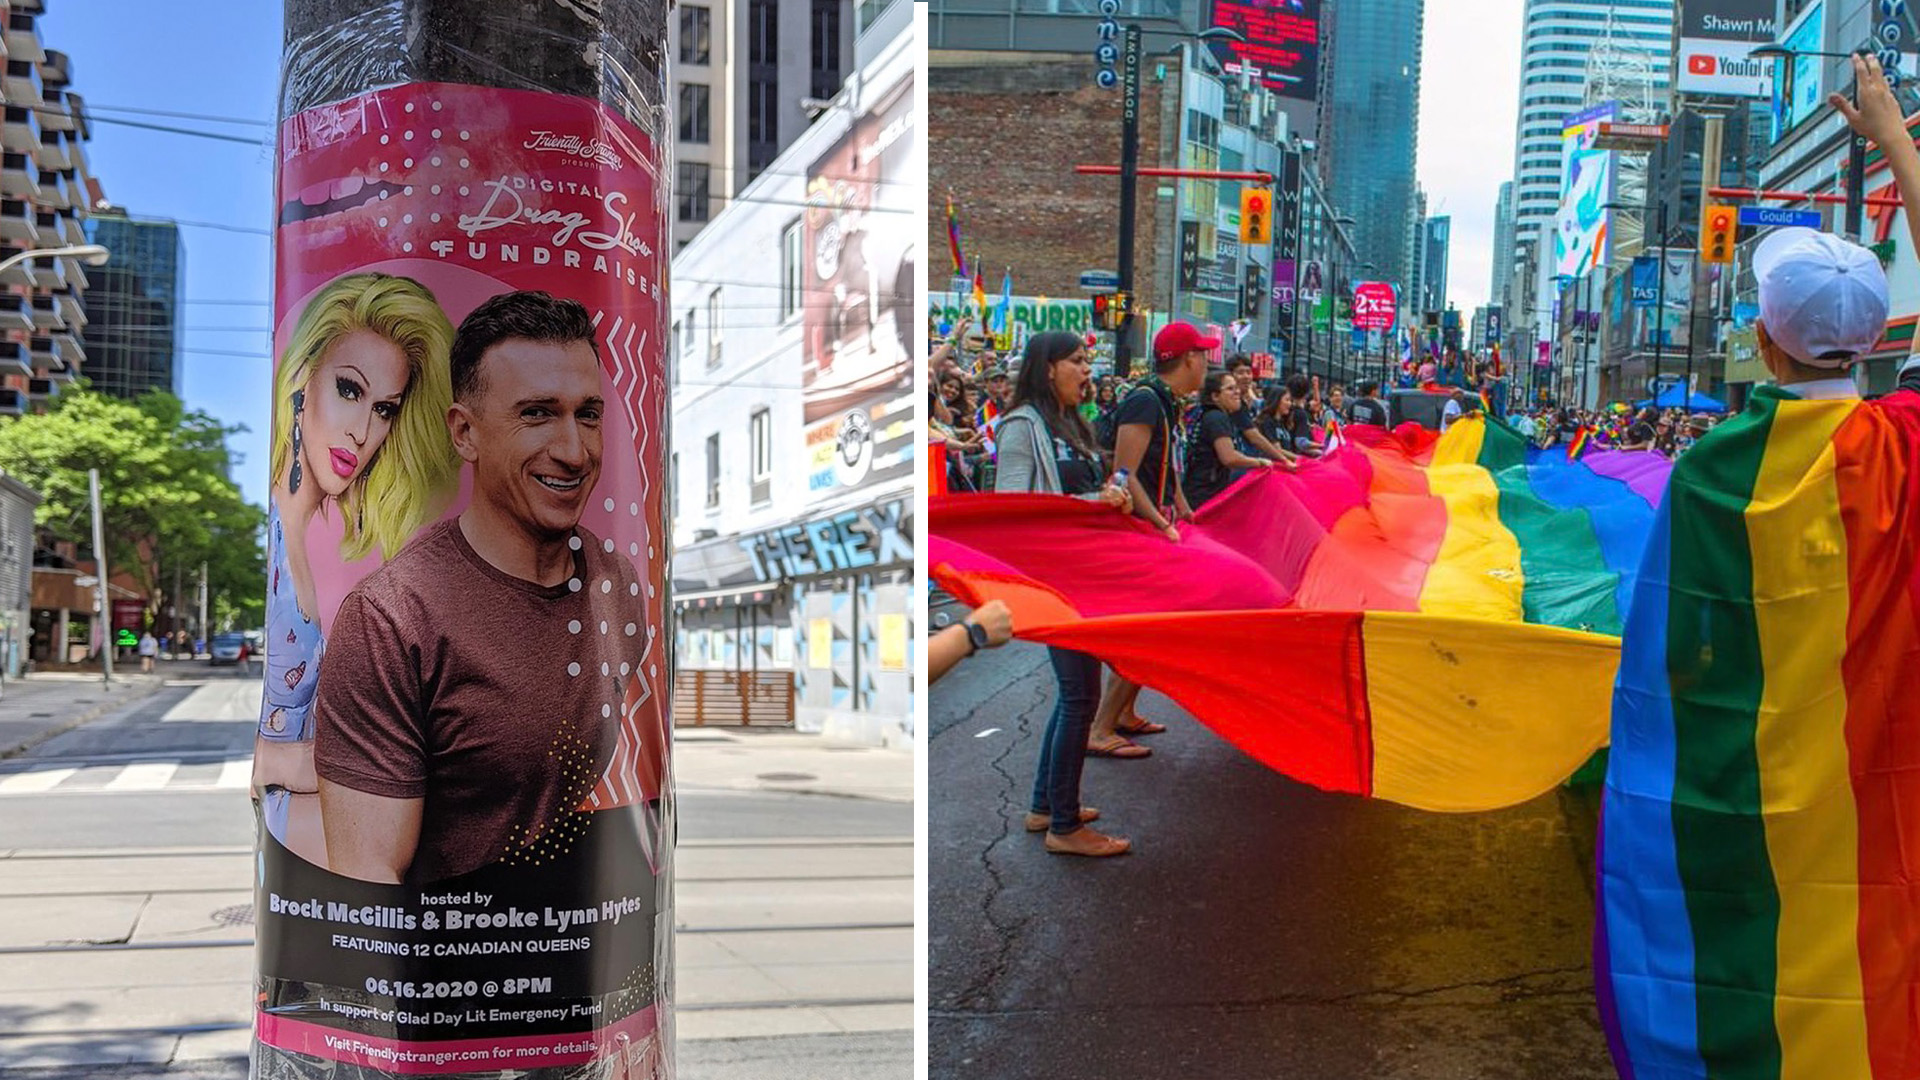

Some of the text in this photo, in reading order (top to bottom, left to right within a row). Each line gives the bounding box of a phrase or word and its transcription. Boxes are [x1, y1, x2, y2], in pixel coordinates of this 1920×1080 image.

[1703, 14, 1752, 31] Shawn
[1125, 30, 1138, 118] DOWNTOWN
[523, 130, 623, 171] Friendly Stranger
[561, 158, 602, 171] presents
[513, 177, 603, 199] DIGITAL
[457, 175, 652, 256] Drag Show
[1759, 210, 1793, 223] Gould
[438, 240, 661, 301] FUNDRAISER
[738, 502, 914, 583] THE REX
[269, 893, 641, 933] Brock McGillis & Brooke Lynn Hytes
[421, 892, 493, 907] hosted by
[332, 934, 591, 956] FEATURING 12 CANADIAN QUEENS
[365, 977, 552, 999] 06.16.2020 @ 8PM
[320, 997, 602, 1027] In support of Glad Day Lit Emergency Fund
[324, 1034, 598, 1066] Visit Friendlystranger.com for more details.
